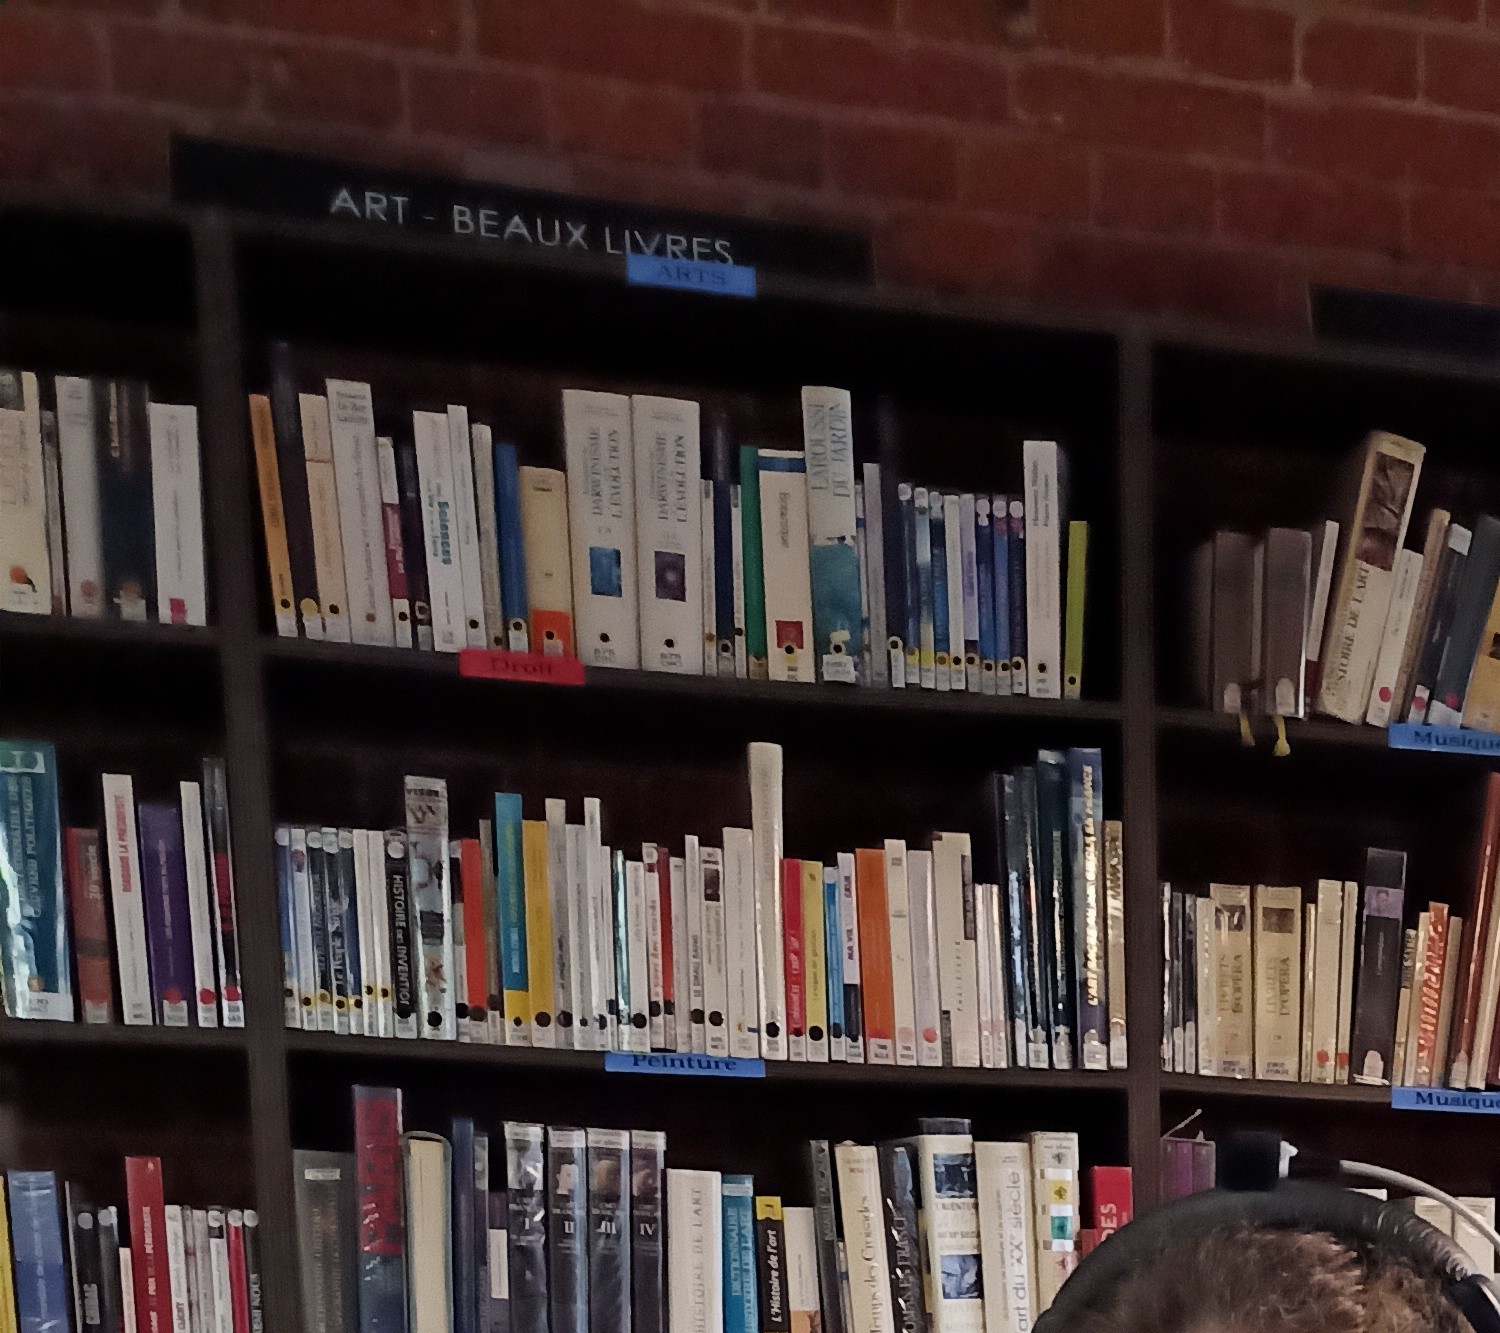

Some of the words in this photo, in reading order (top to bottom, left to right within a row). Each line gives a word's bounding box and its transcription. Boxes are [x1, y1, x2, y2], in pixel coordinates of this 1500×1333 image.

[330, 187, 409, 224] ART
[452, 204, 588, 251] BEAUX
[605, 225, 733, 266] LIVRES
[1009, 1273, 1027, 1302] du
